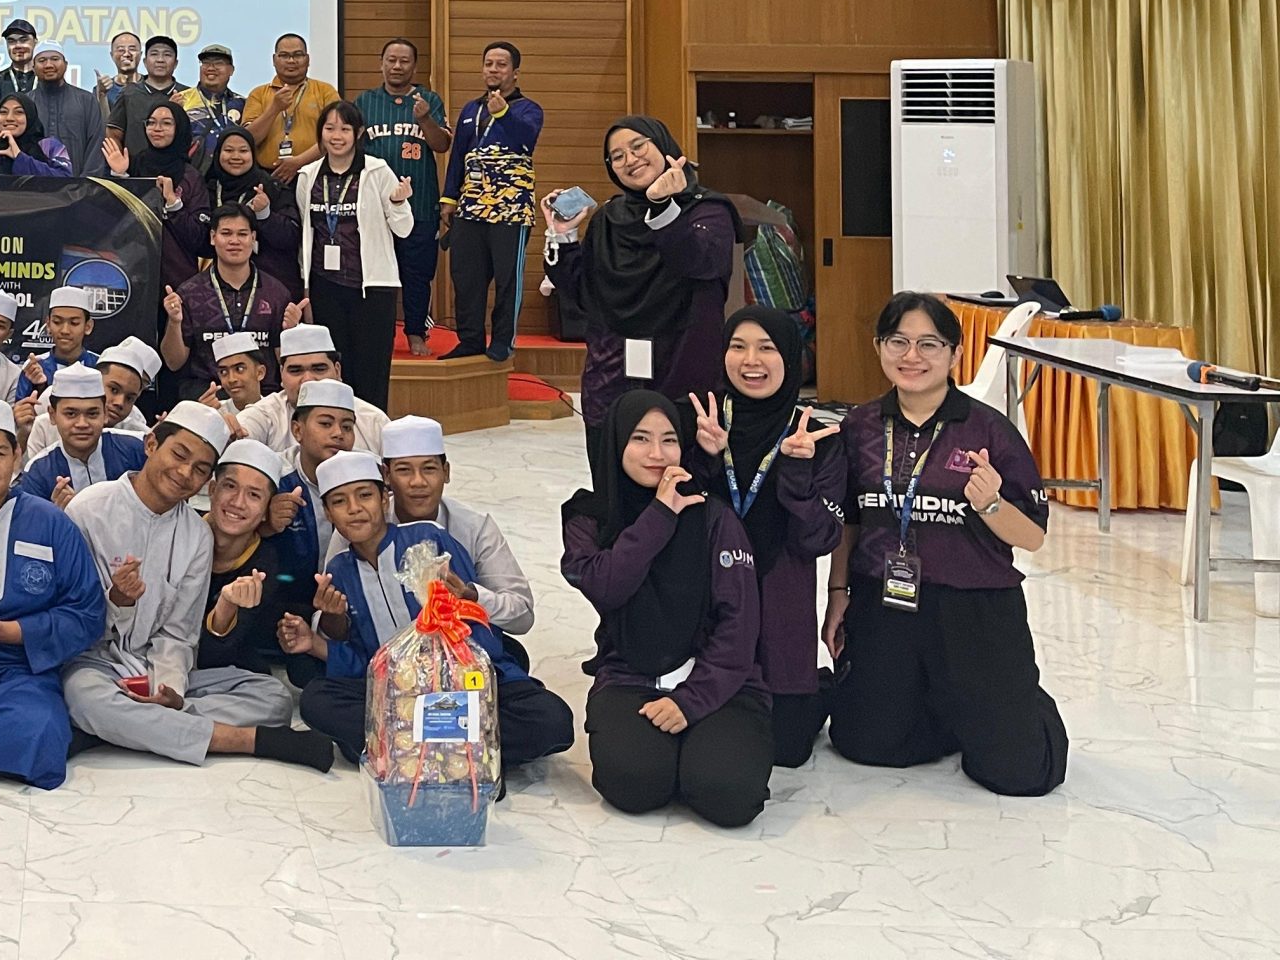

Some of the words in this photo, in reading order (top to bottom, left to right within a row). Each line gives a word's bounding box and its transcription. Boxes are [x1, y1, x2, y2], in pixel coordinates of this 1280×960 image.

[24, 6, 201, 46] DATANG
[366, 123, 391, 140] ALL
[401, 142, 421, 160] 28
[203, 331, 269, 341] PEDIK
[470, 676, 477, 687] 1
